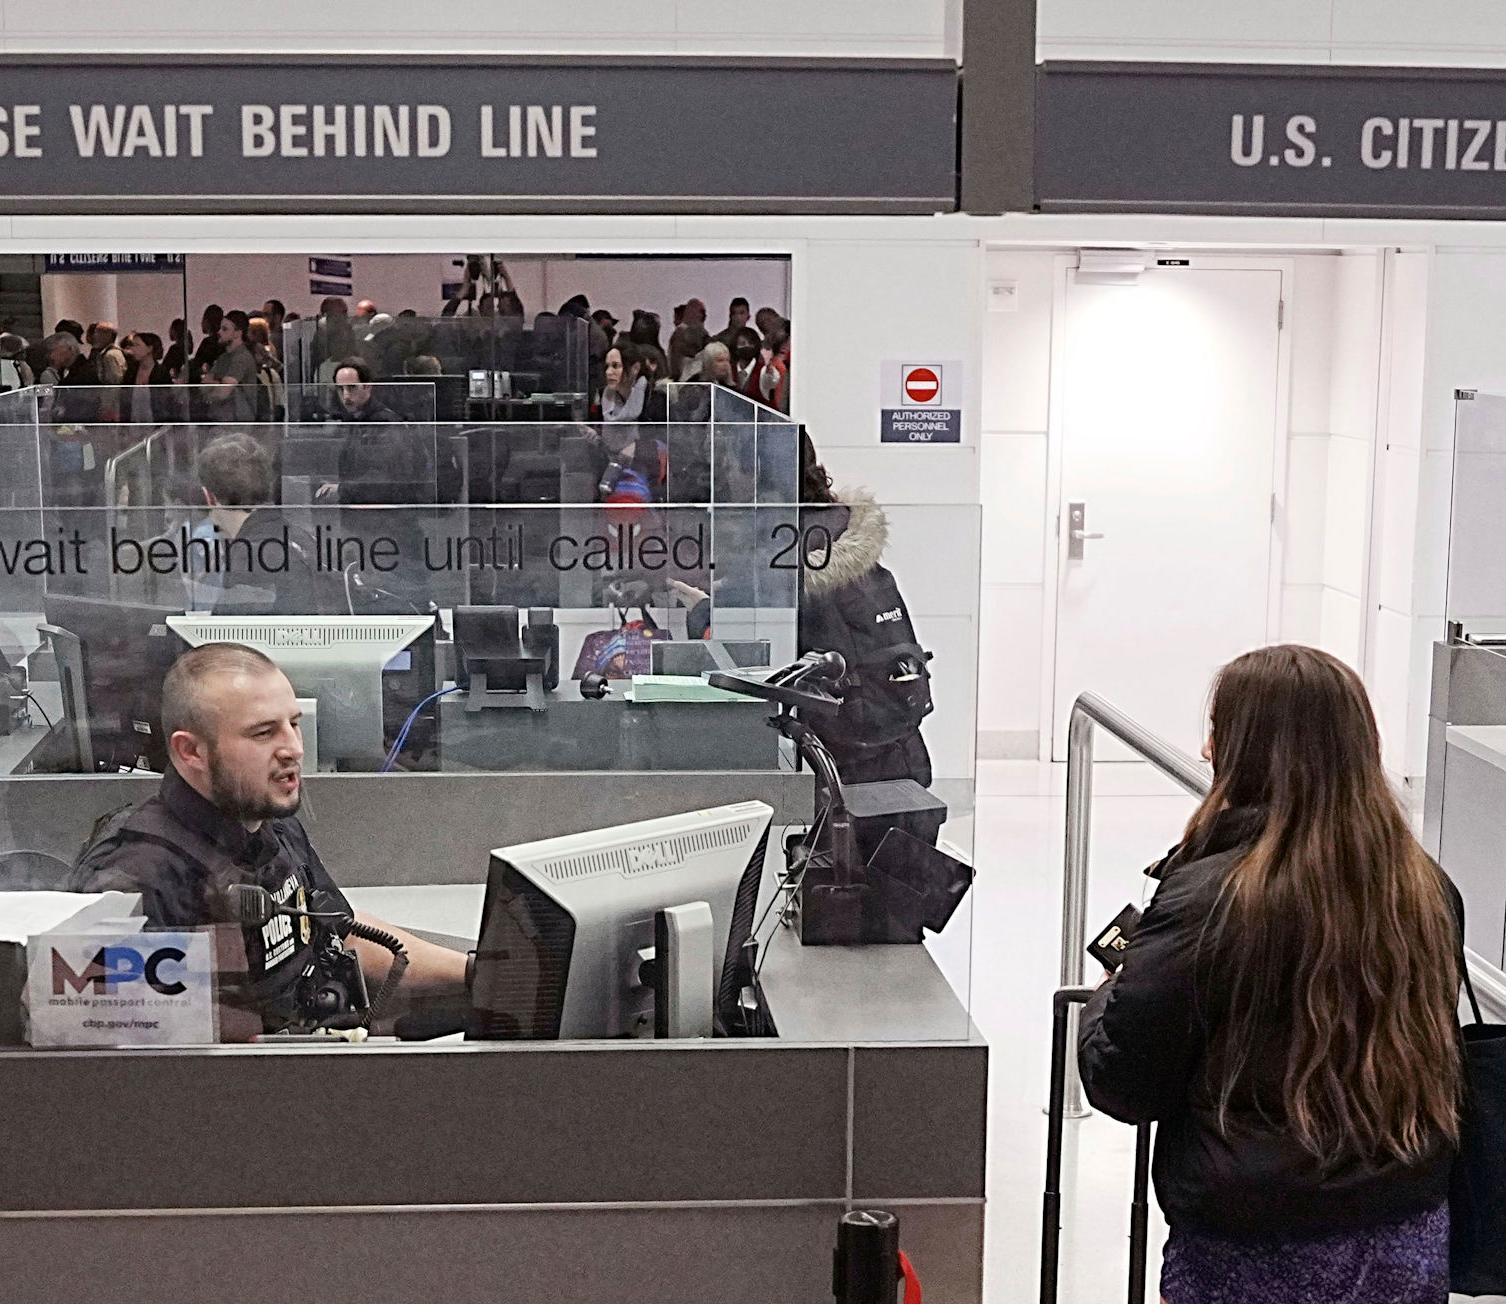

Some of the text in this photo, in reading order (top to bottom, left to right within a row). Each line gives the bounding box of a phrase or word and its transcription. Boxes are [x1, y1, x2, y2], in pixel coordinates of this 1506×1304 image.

[69, 104, 214, 157] WAIT
[241, 104, 452, 157] BEHIND
[481, 104, 598, 157] LINE
[1230, 114, 1332, 168] U.S.
[891, 411, 951, 421] AUTHORIZED
[893, 422, 950, 431] PERSONNEL
[908, 432, 934, 441] ONLY
[110, 525, 291, 575] behind
[315, 524, 401, 572] line
[424, 523, 524, 572] until
[548, 523, 716, 571] called.
[769, 523, 833, 571] 20
[51, 946, 188, 995] MPC
[48, 998, 191, 1008] mobile passport control
[82, 1019, 160, 1031] cbp.gov/mpc
